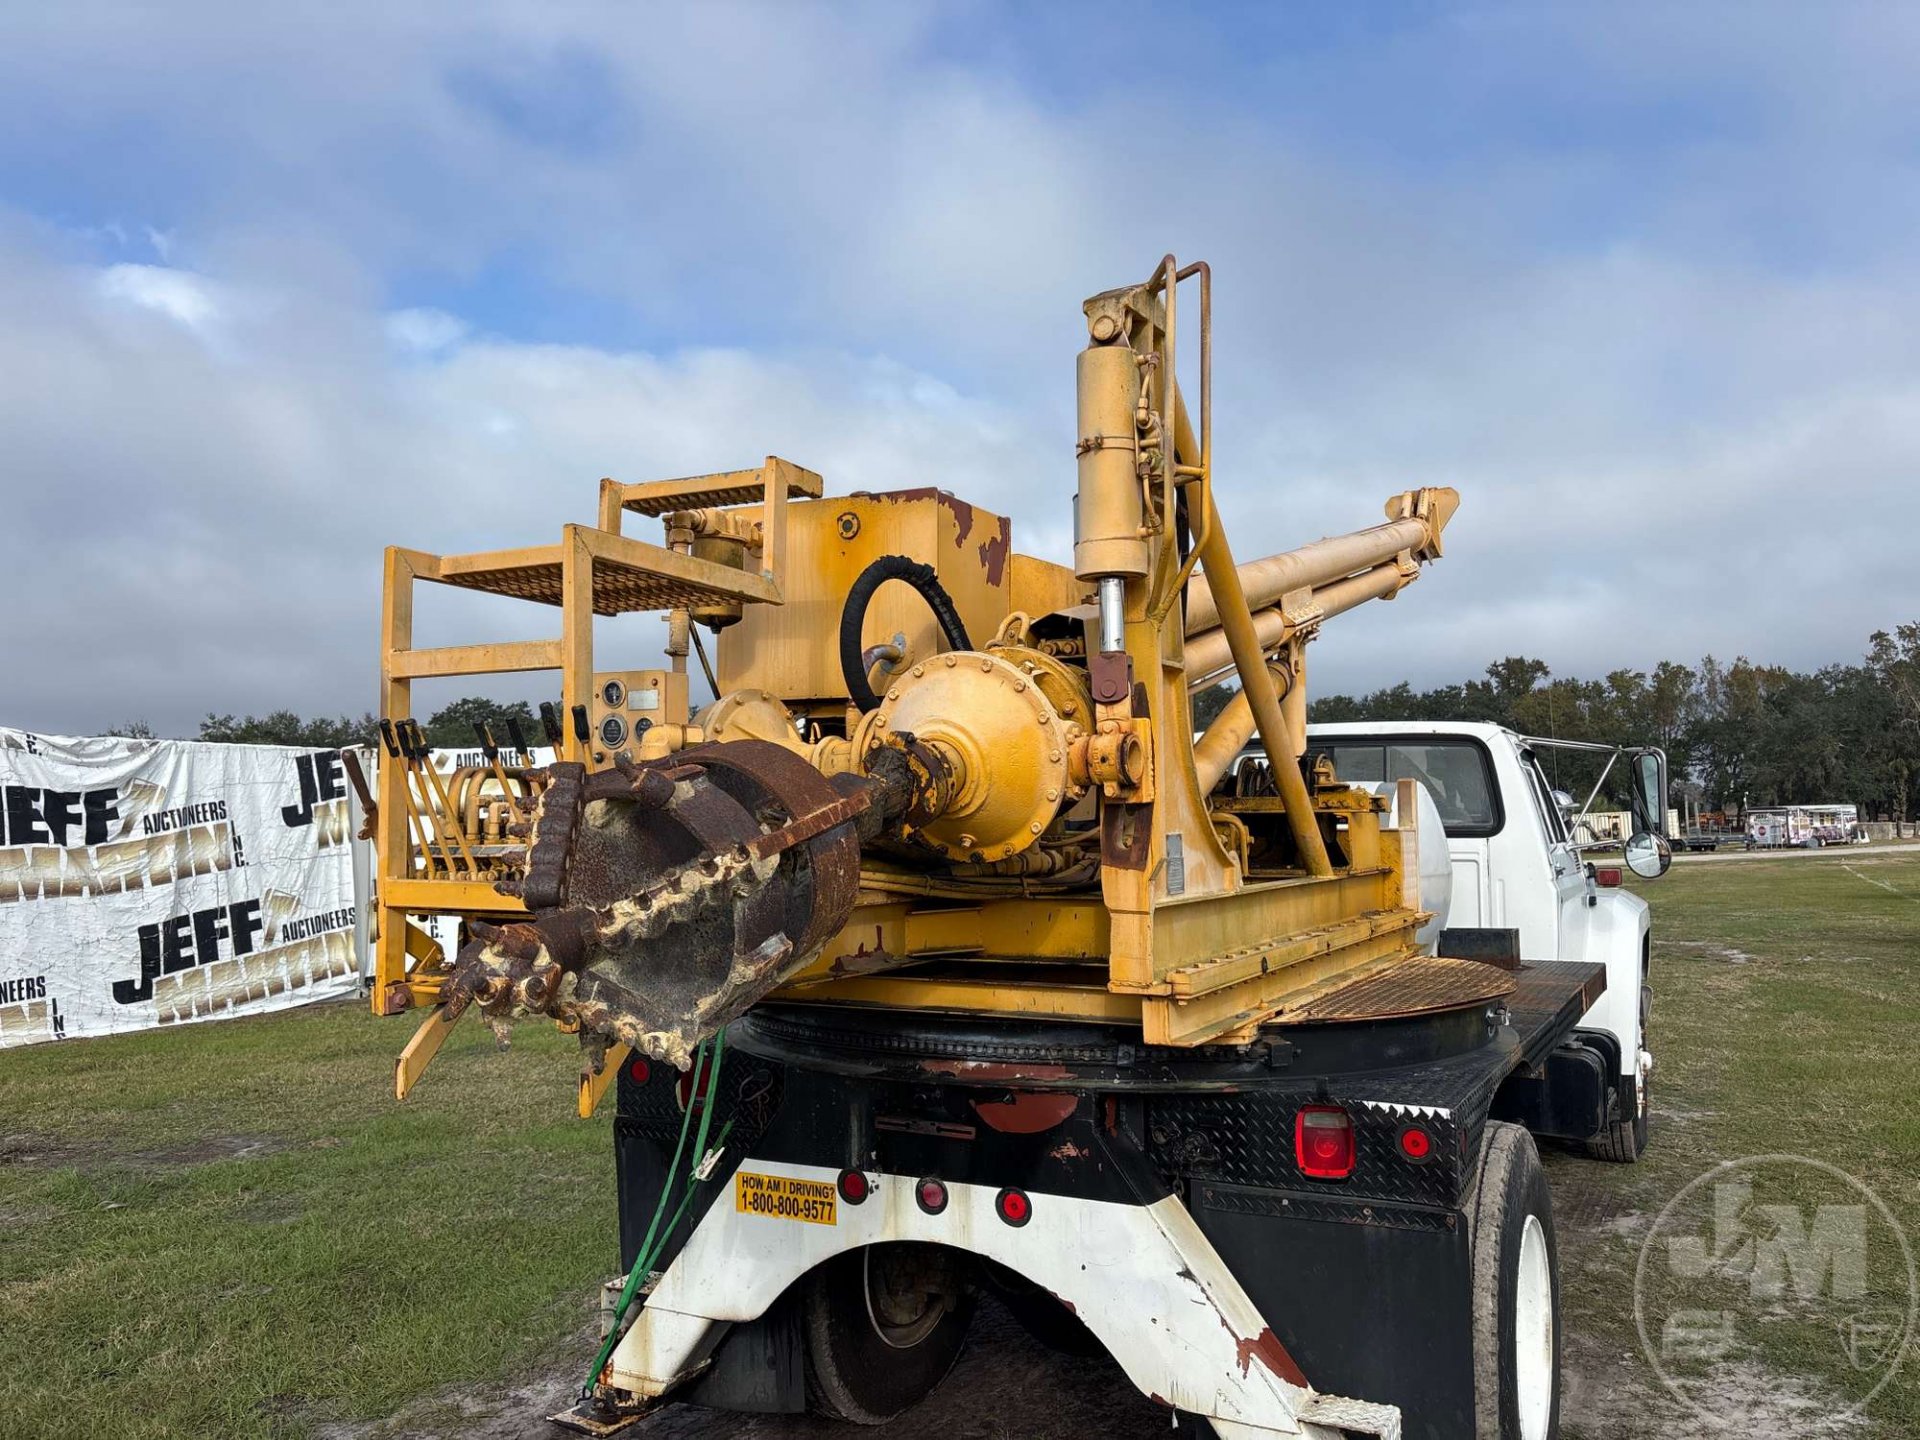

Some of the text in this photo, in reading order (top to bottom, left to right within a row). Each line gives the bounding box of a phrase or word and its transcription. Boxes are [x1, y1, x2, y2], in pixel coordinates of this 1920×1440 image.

[456, 749, 536, 768] AUCTINEES
[281, 749, 347, 828] JE
[0, 785, 119, 846] EFF
[143, 800, 227, 835] AUCTIONEERS
[231, 820, 249, 867] INC.
[282, 907, 356, 943] AUCTIONEERS
[112, 898, 263, 1005] JEFF
[741, 1176, 835, 1199] HOW AM I DRIVING?
[741, 1190, 834, 1221] 1-800-800-9577
